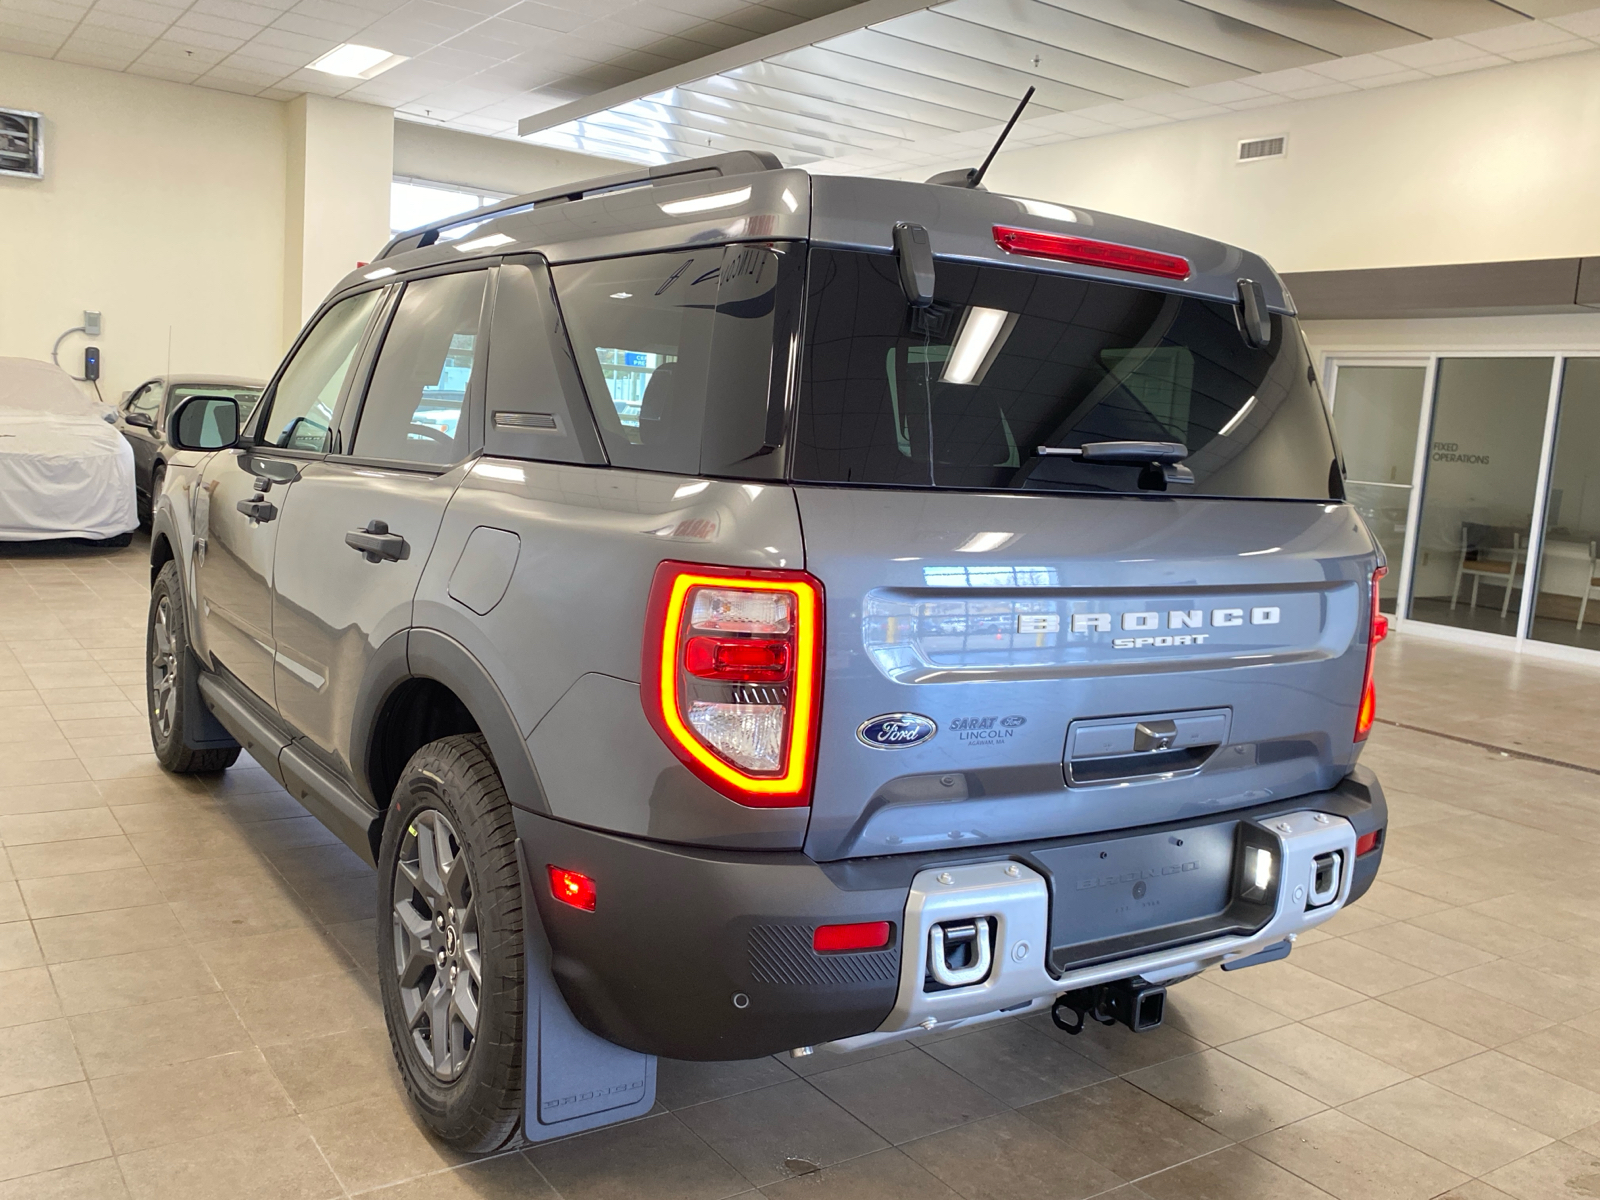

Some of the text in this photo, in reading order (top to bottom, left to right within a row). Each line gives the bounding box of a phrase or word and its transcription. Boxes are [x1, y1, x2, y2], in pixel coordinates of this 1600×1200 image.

[1433, 442, 1458, 452] FIXED
[1432, 452, 1490, 465] OPERATIONS
[1017, 606, 1281, 634] BRONCO
[1111, 634, 1209, 649] SPORT
[877, 720, 921, 742] Ford
[949, 716, 999, 732] SARAT
[959, 729, 1014, 741] LINCOLN
[1076, 860, 1200, 891] BRONCO
[543, 1080, 644, 1110] BRONCO
